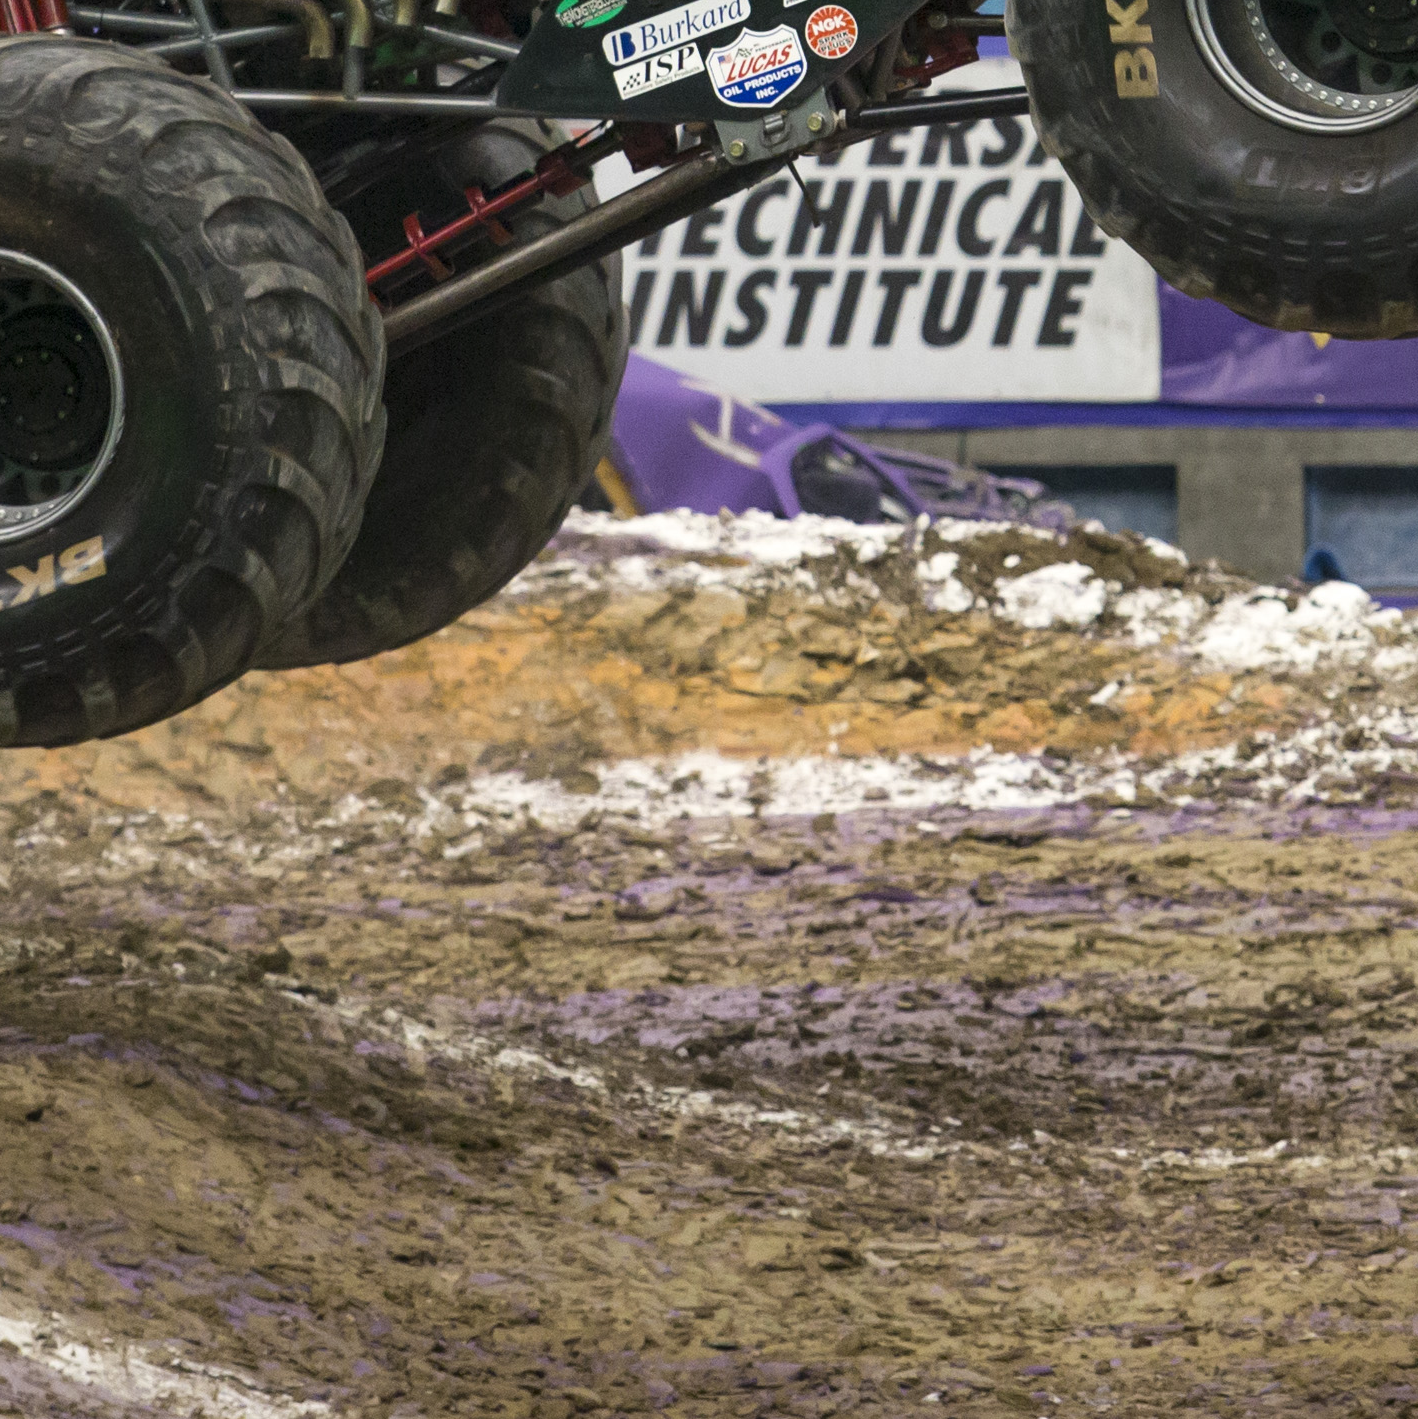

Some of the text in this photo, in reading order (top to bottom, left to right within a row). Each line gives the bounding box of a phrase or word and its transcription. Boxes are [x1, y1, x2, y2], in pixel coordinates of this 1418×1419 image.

[810, 13, 847, 37] NGK
[817, 31, 849, 46] SPARK
[819, 36, 853, 53] PLUGS
[644, 46, 695, 84] ISP
[725, 43, 793, 83] LUCAS
[723, 64, 802, 99] OIL PRODUCTS
[755, 88, 779, 100] INC.
[628, 268, 1095, 348] INSTITUTE
